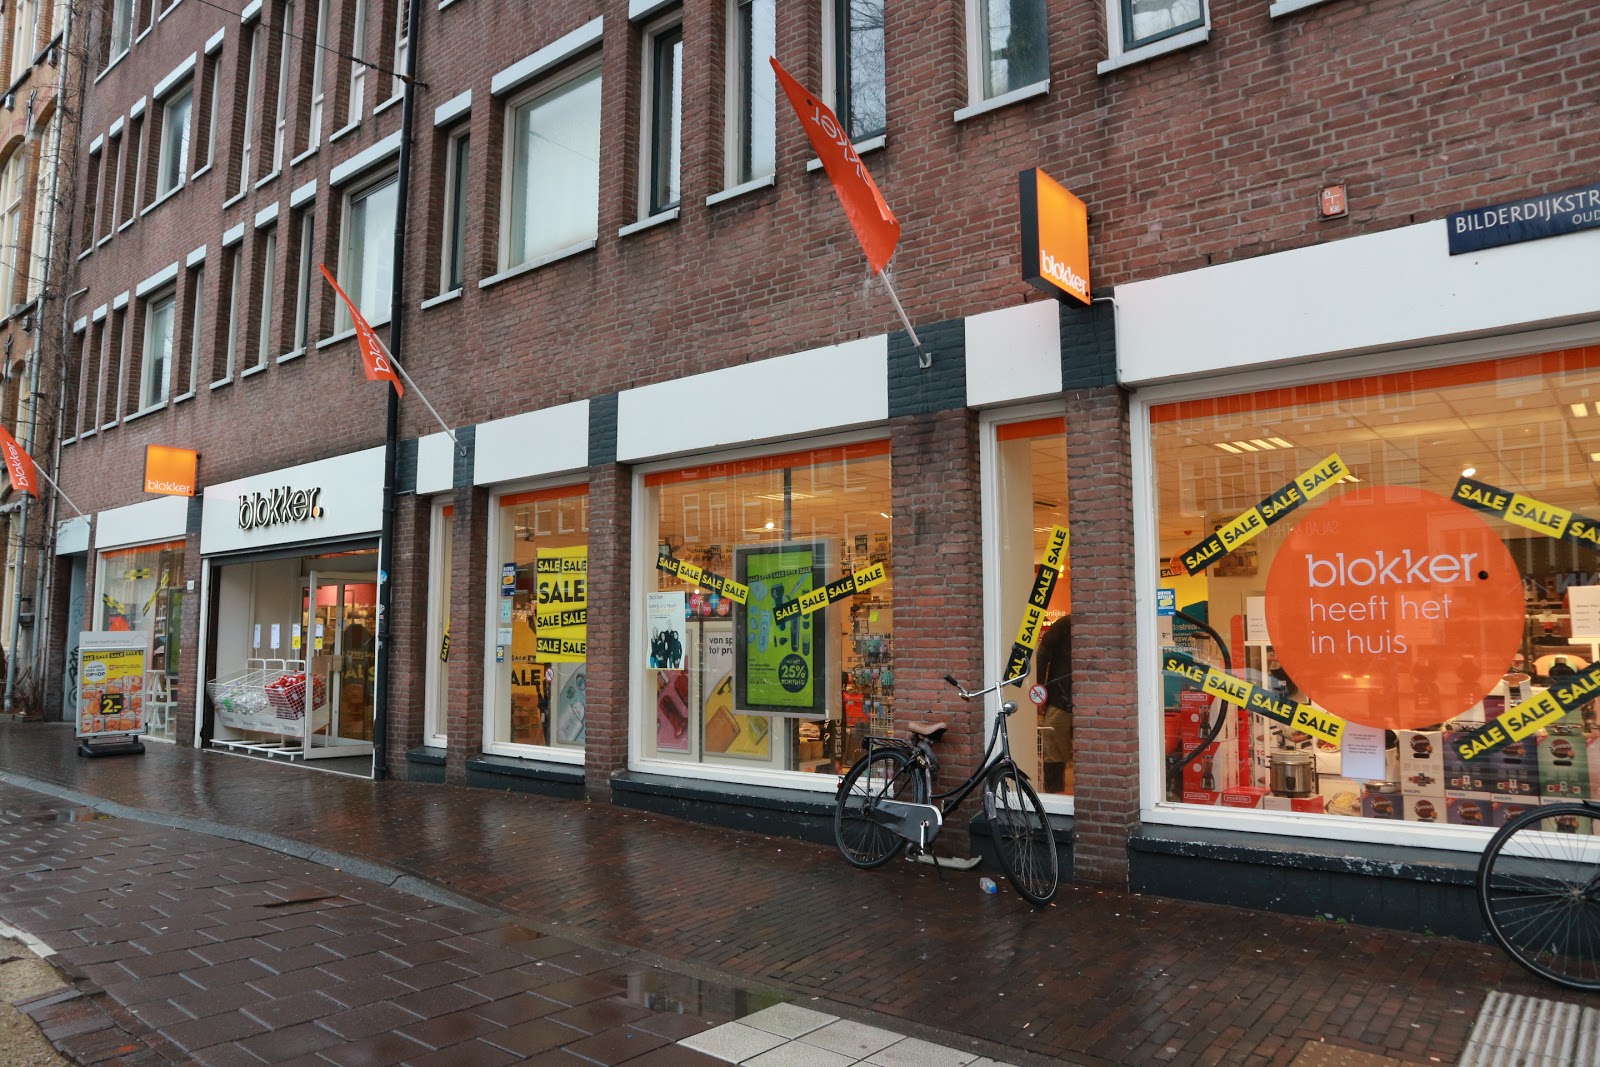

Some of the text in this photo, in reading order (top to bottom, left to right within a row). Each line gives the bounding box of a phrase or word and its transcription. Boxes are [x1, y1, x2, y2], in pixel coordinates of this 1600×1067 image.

[1186, 460, 1342, 569] SALE SALE SALE SALE
[1457, 484, 1507, 510] SALE
[1512, 503, 1563, 529] SALE
[538, 560, 587, 572] SALE SALE
[658, 557, 746, 599] SALE SALE SALE SALE
[538, 579, 585, 604] SALE
[776, 568, 883, 621] SALE SALE SALE SALE
[1008, 530, 1067, 681] SALE SALE SALE SAL
[1310, 594, 1452, 621] heeft het
[538, 611, 587, 627] SALE SALE
[537, 639, 586, 654] SALE SALE
[709, 646, 720, 654] tot
[1311, 629, 1408, 654] in huis
[510, 669, 541, 686] ALE
[781, 664, 806, 678] 25%
[1166, 659, 1340, 737] SALE SALE SALE SALE
[1459, 727, 1506, 760] SALE
[1507, 699, 1555, 732] SALE
